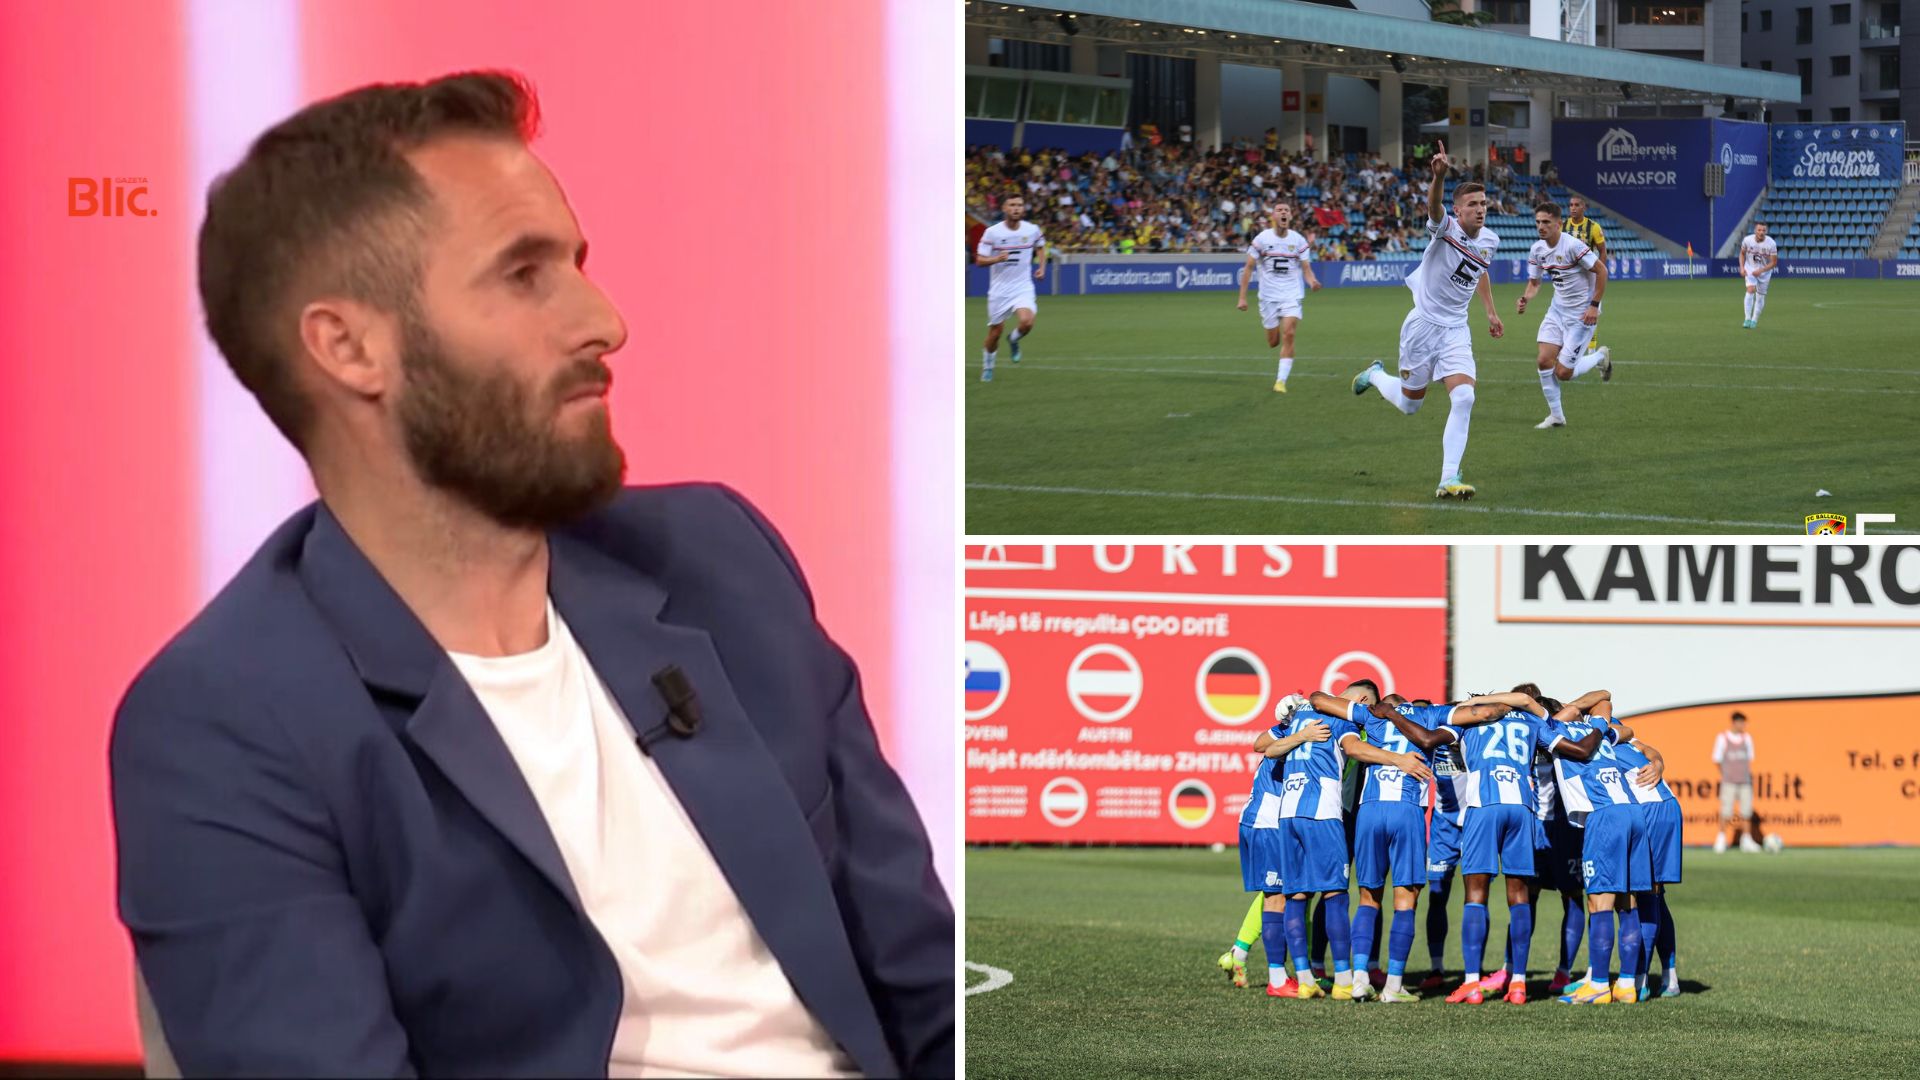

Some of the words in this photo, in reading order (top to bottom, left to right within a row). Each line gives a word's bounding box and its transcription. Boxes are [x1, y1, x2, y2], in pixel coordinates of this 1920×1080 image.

[1801, 143, 1847, 166] Sense
[1848, 149, 1875, 166] por
[1597, 171, 1677, 185] NAVASFOR
[1090, 269, 1172, 285] visitandorra.com
[1191, 269, 1233, 286] Andorra
[1450, 274, 1469, 288] CIMA
[969, 612, 1016, 635] Linja
[1077, 726, 1133, 743] AUSTRI
[1479, 722, 1530, 765] 26
